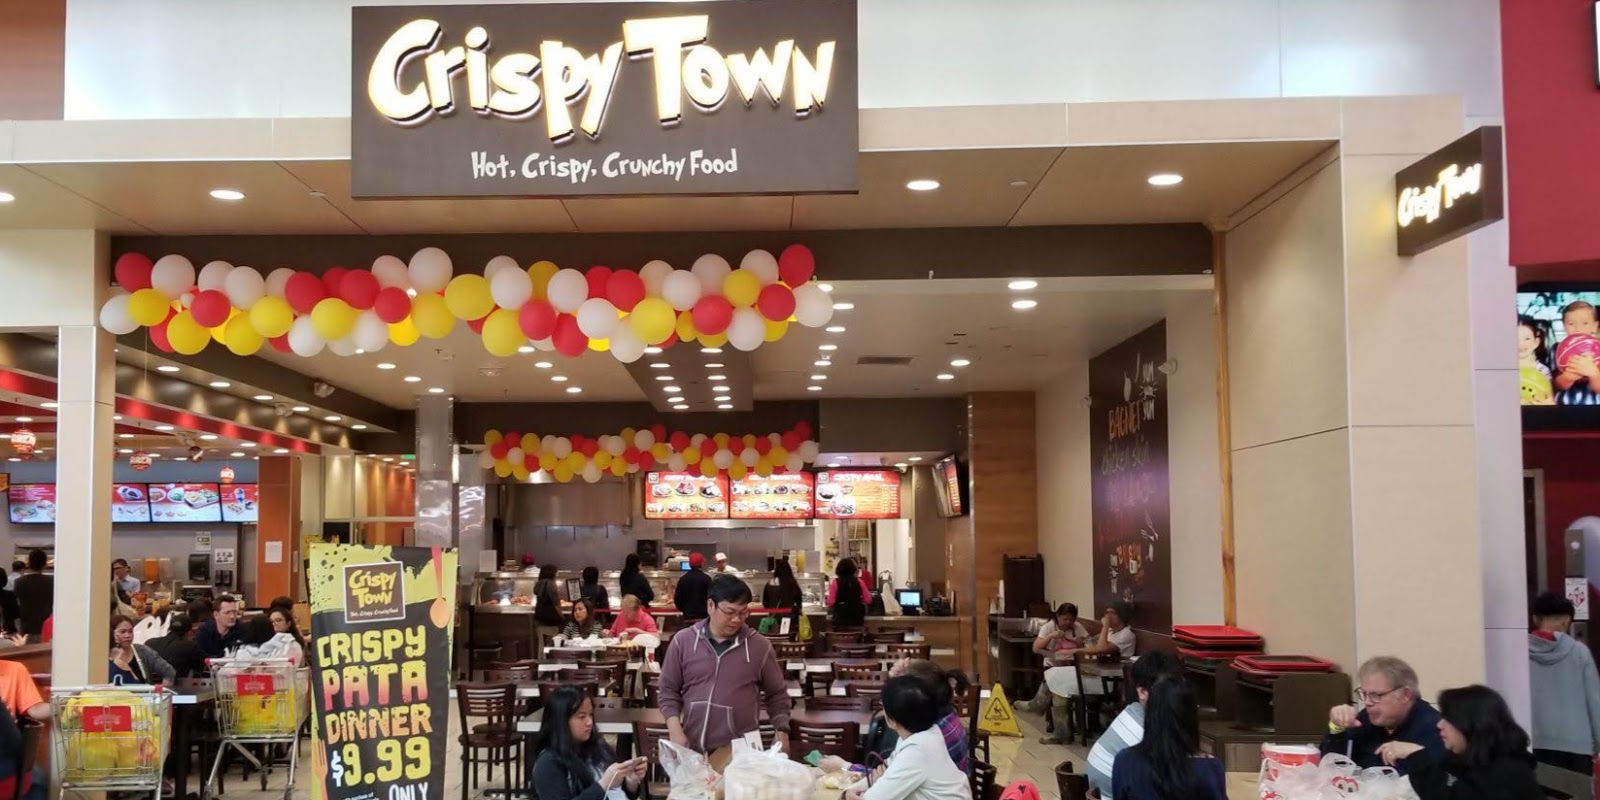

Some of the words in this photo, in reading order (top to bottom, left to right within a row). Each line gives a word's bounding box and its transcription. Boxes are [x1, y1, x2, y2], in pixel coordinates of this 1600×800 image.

[368, 19, 624, 142] Crispy
[623, 15, 836, 125] Town
[471, 151, 516, 179] Hot,
[522, 153, 597, 183] Crispy,
[690, 148, 738, 175] Food
[349, 569, 396, 590] Crispy
[317, 625, 426, 667] CRISPY
[321, 660, 429, 711] PATA
[325, 703, 433, 744] DINNER
[331, 736, 431, 787] $9.99
